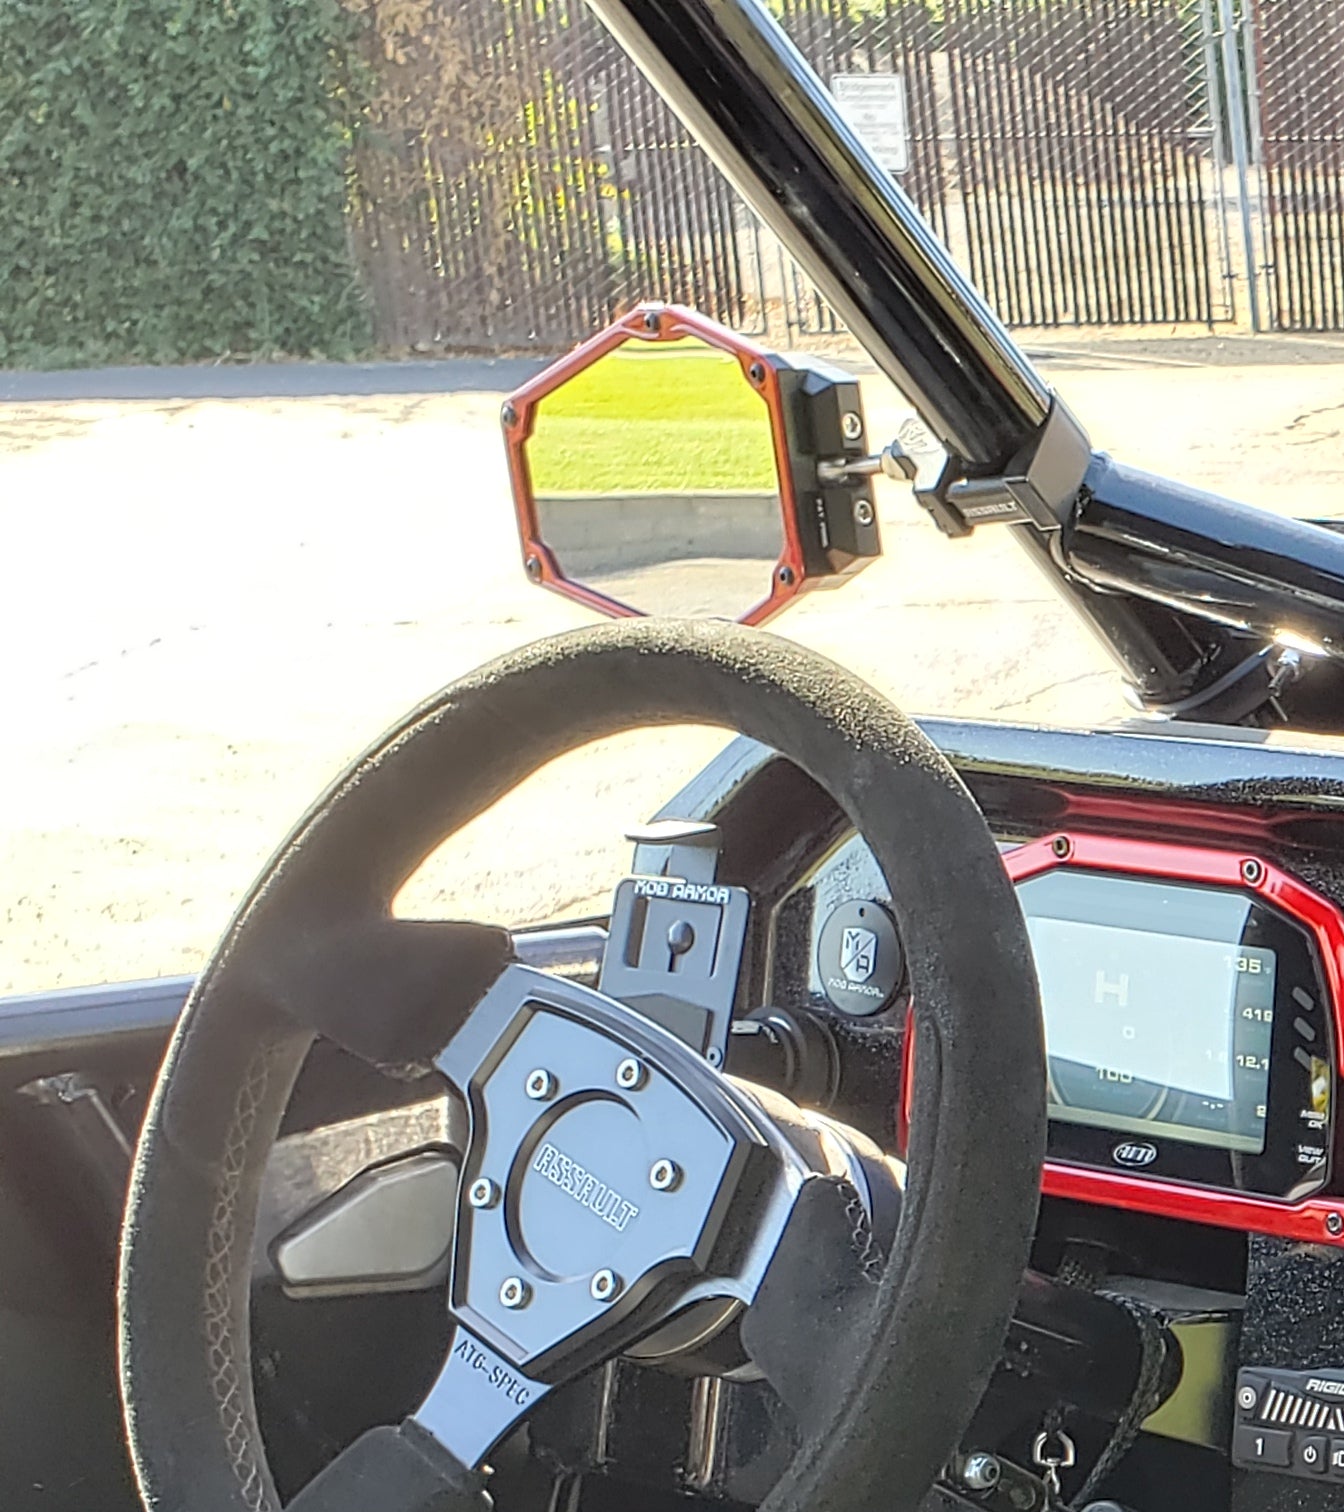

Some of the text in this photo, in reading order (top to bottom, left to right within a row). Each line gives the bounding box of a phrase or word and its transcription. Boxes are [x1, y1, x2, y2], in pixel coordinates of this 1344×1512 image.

[634, 880, 730, 903] MOB ARMOR
[533, 1143, 639, 1232] ASSAULT
[1255, 1438, 1264, 1456] 1
